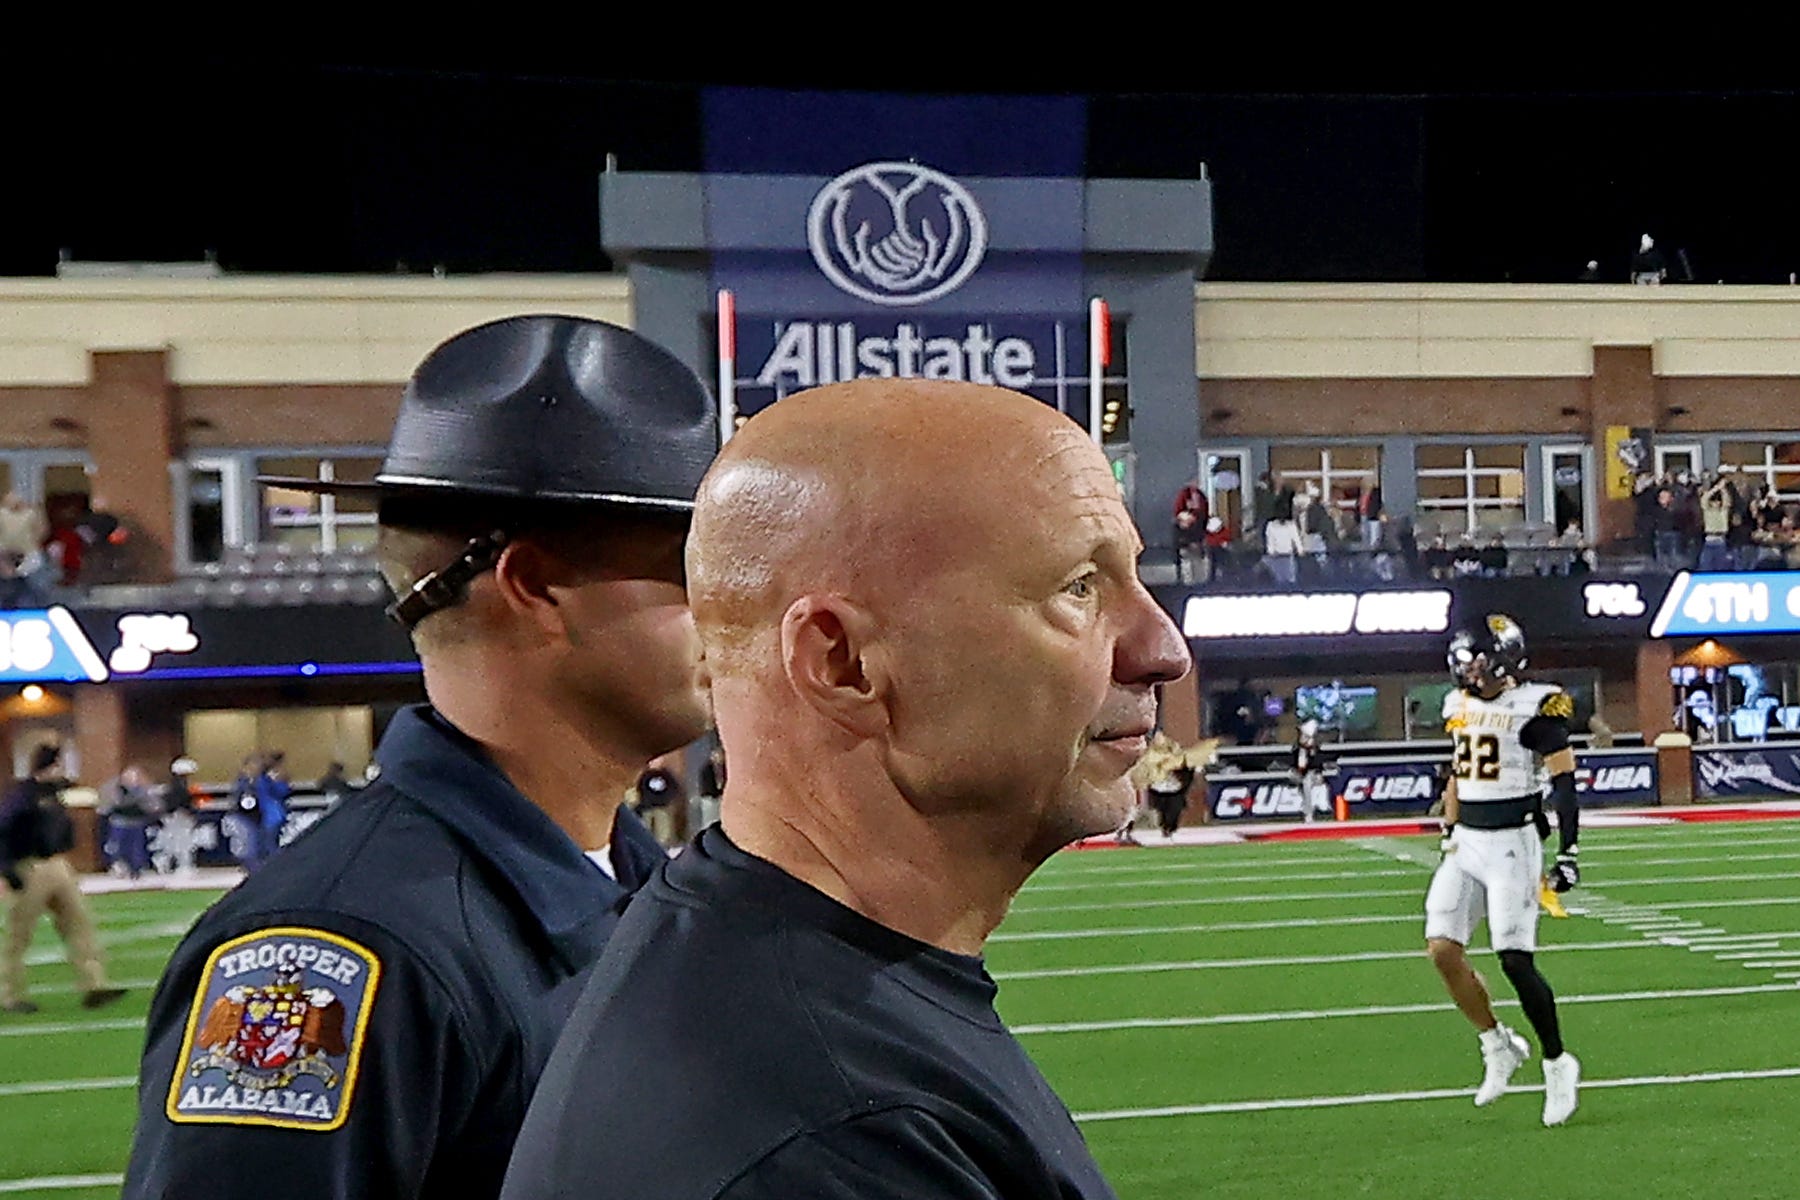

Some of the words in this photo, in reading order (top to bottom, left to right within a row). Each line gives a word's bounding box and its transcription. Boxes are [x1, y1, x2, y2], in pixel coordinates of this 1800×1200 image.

[757, 320, 1035, 388] Allstate
[1683, 582, 1768, 623] 4TH
[1454, 734, 1500, 781] 22
[219, 944, 360, 985] TROOPER
[177, 1085, 332, 1119] ALABAMA
